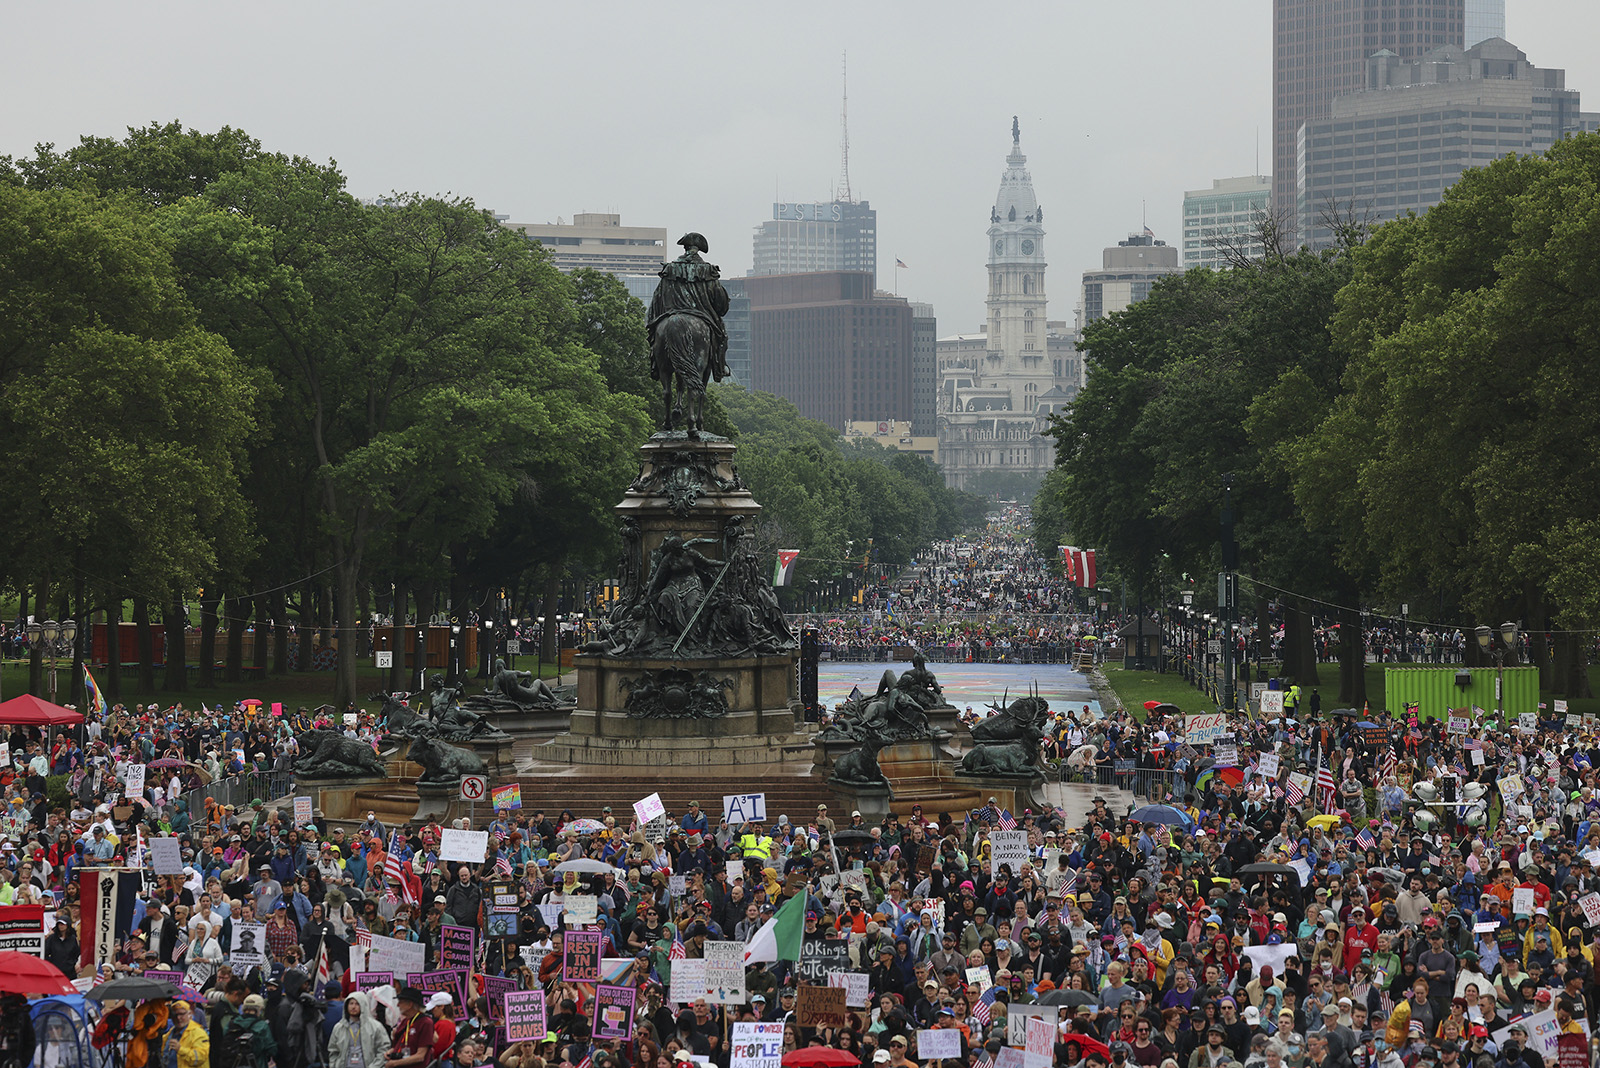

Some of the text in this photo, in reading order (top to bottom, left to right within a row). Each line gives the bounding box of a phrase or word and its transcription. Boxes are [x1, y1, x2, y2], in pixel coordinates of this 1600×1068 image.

[778, 203, 842, 221] PSFS
[1186, 714, 1221, 733] FUCK
[1188, 726, 1224, 742] TRUMP
[996, 832, 1021, 841] BEING
[847, 873, 864, 885] KING
[256, 886, 272, 895] USA
[497, 896, 516, 904] SELLS
[99, 898, 111, 964] RESIST
[444, 929, 470, 940] MASS
[444, 940, 470, 951] AMERICAN
[567, 942, 598, 954] REST
[705, 942, 743, 951] IMMIGRANTS
[444, 951, 470, 961] GRAVES
[574, 955, 590, 966] IN
[708, 952, 722, 960] ARE
[707, 960, 741, 969] AMERICAN
[566, 967, 598, 979] PEACE
[724, 970, 743, 979] TANKS
[359, 976, 378, 984] TRUMP
[434, 975, 444, 984] WILL
[714, 978, 725, 986] OUR
[427, 981, 455, 993] REST
[800, 987, 817, 996] THIS
[600, 988, 632, 998] FROM OUR COLD
[599, 997, 632, 1006] DEAD HANDS
[807, 996, 843, 1005] NORMAL
[492, 1004, 504, 1018] AI
[509, 1004, 542, 1013] POLICY:
[509, 1014, 542, 1023] DIG MORE
[510, 1023, 543, 1038] GRAVES
[754, 1024, 783, 1033] POWER
[1536, 1019, 1558, 1036] SENT
[734, 1043, 779, 1058] PEOPLE
